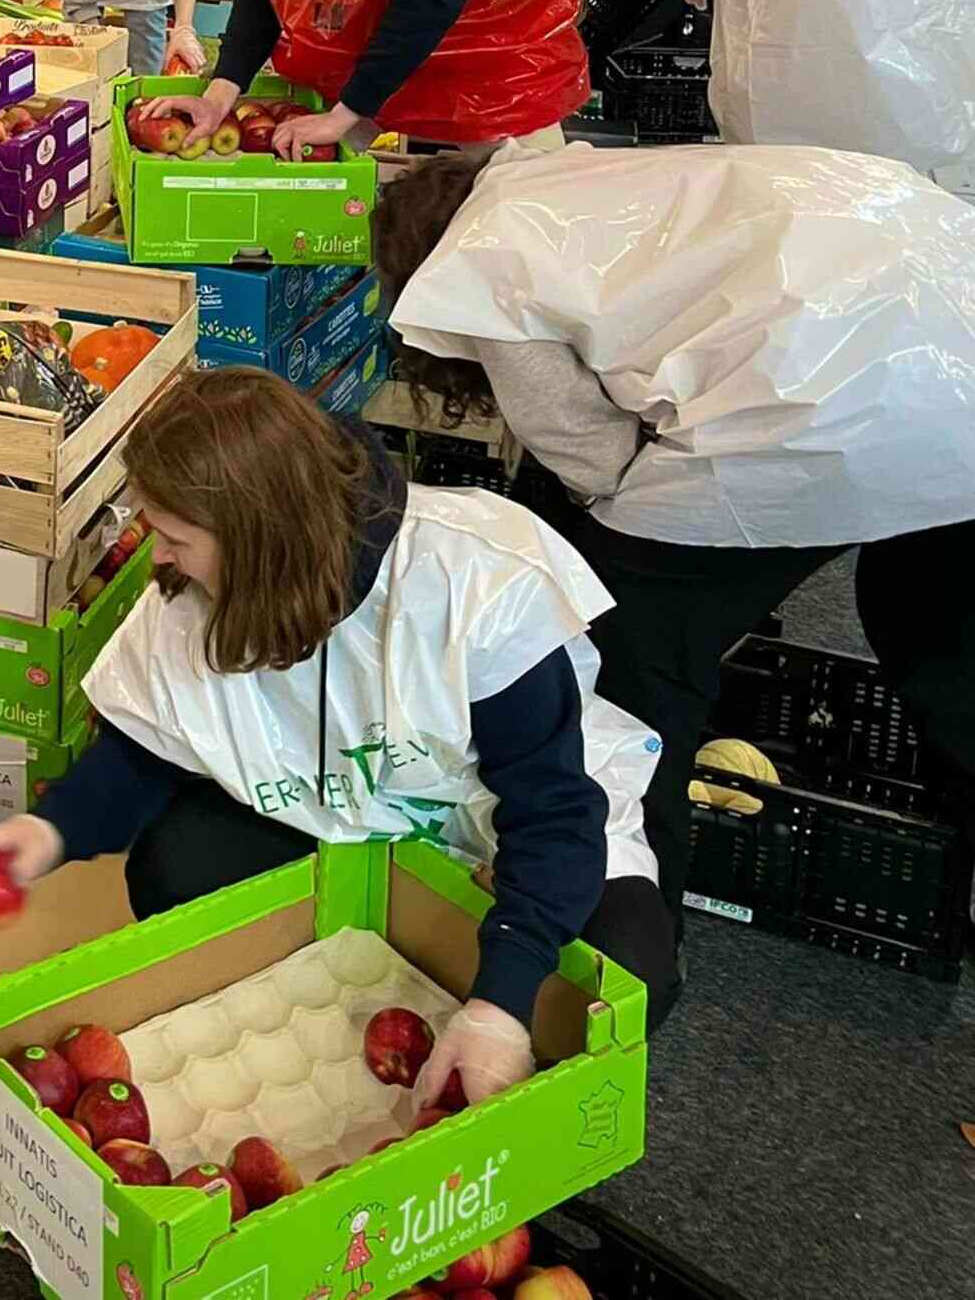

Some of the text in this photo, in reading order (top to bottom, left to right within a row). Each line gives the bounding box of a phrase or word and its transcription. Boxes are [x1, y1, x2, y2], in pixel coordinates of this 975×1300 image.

[5, 1113, 58, 1179] INNATIS
[18, 1161, 89, 1248] LOGISTICA
[27, 1213, 65, 1261] STAND
